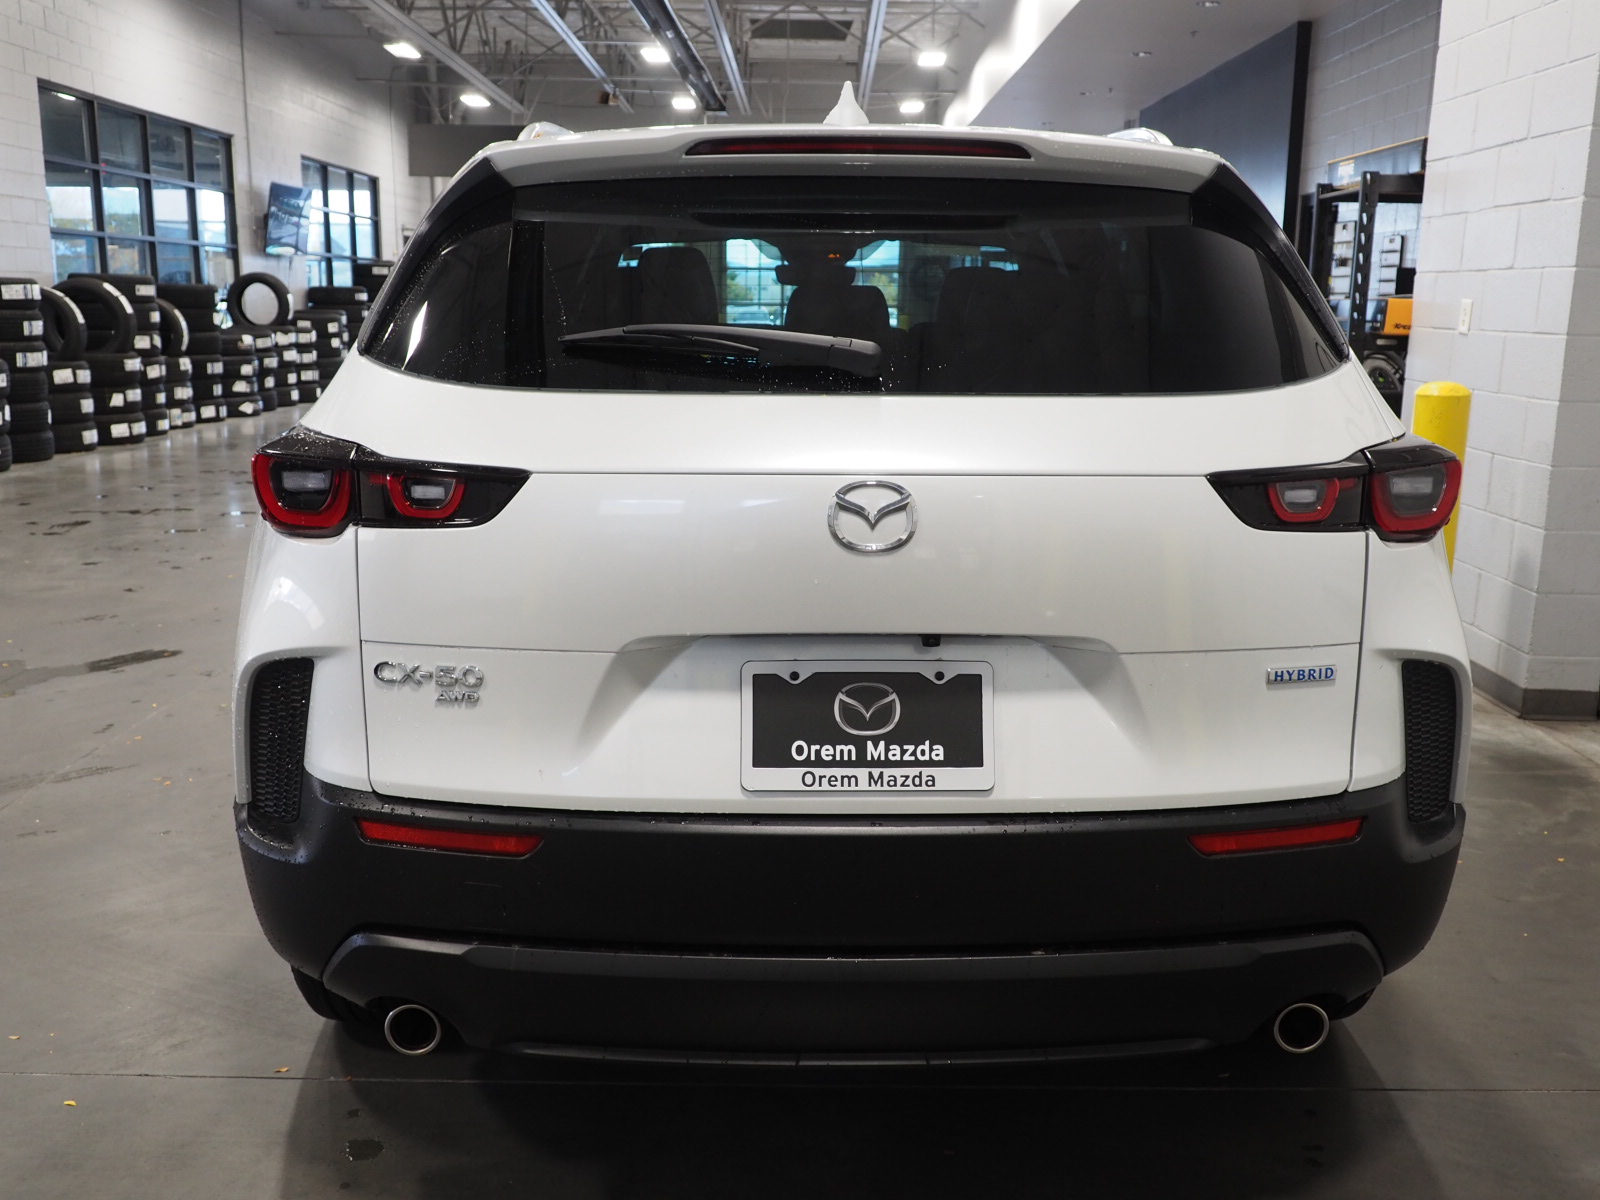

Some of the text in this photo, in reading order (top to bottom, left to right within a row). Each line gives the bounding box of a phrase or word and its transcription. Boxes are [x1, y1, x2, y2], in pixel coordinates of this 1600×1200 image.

[373, 660, 485, 688] CX-50
[1274, 667, 1334, 682] HYBRID
[435, 690, 480, 702] AWD
[790, 739, 945, 761] Orem Mazda
[801, 770, 937, 788] Orem Mazda
